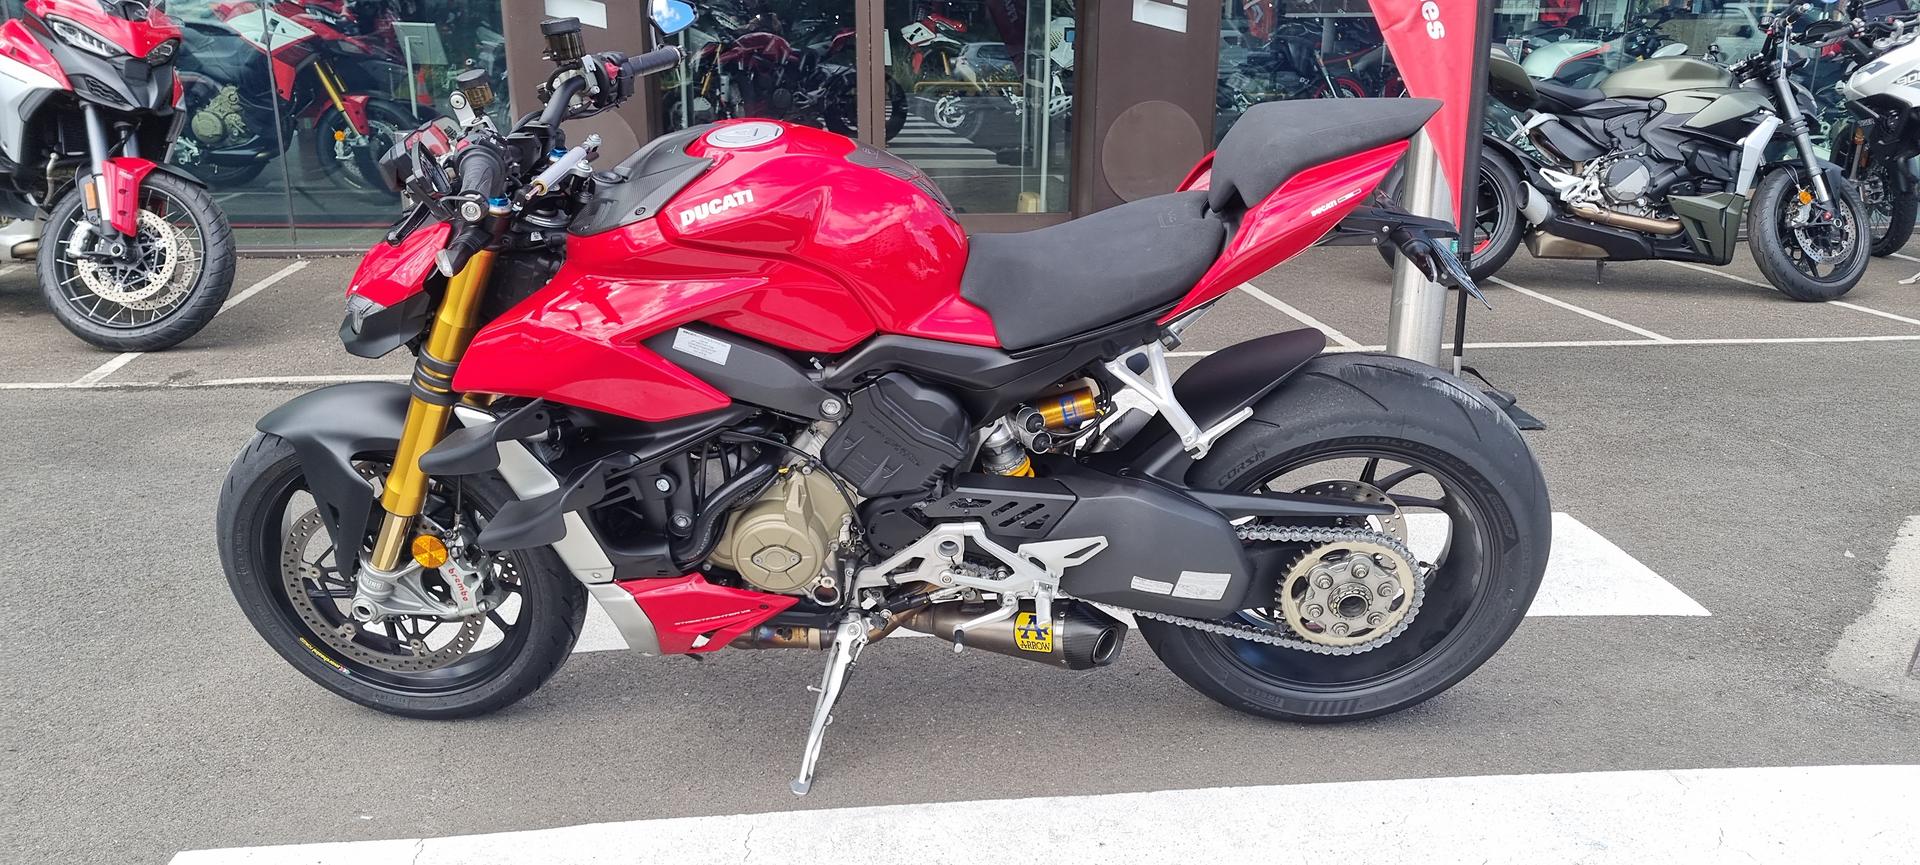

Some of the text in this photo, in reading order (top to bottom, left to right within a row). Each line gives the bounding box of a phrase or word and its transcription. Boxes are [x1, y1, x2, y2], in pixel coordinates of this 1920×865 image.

[1421, 0, 1446, 39] es
[680, 189, 754, 227] DUCATI
[1310, 199, 1338, 217] DUCATI
[448, 567, 469, 602] brembo
[1019, 640, 1052, 651] ARROW
